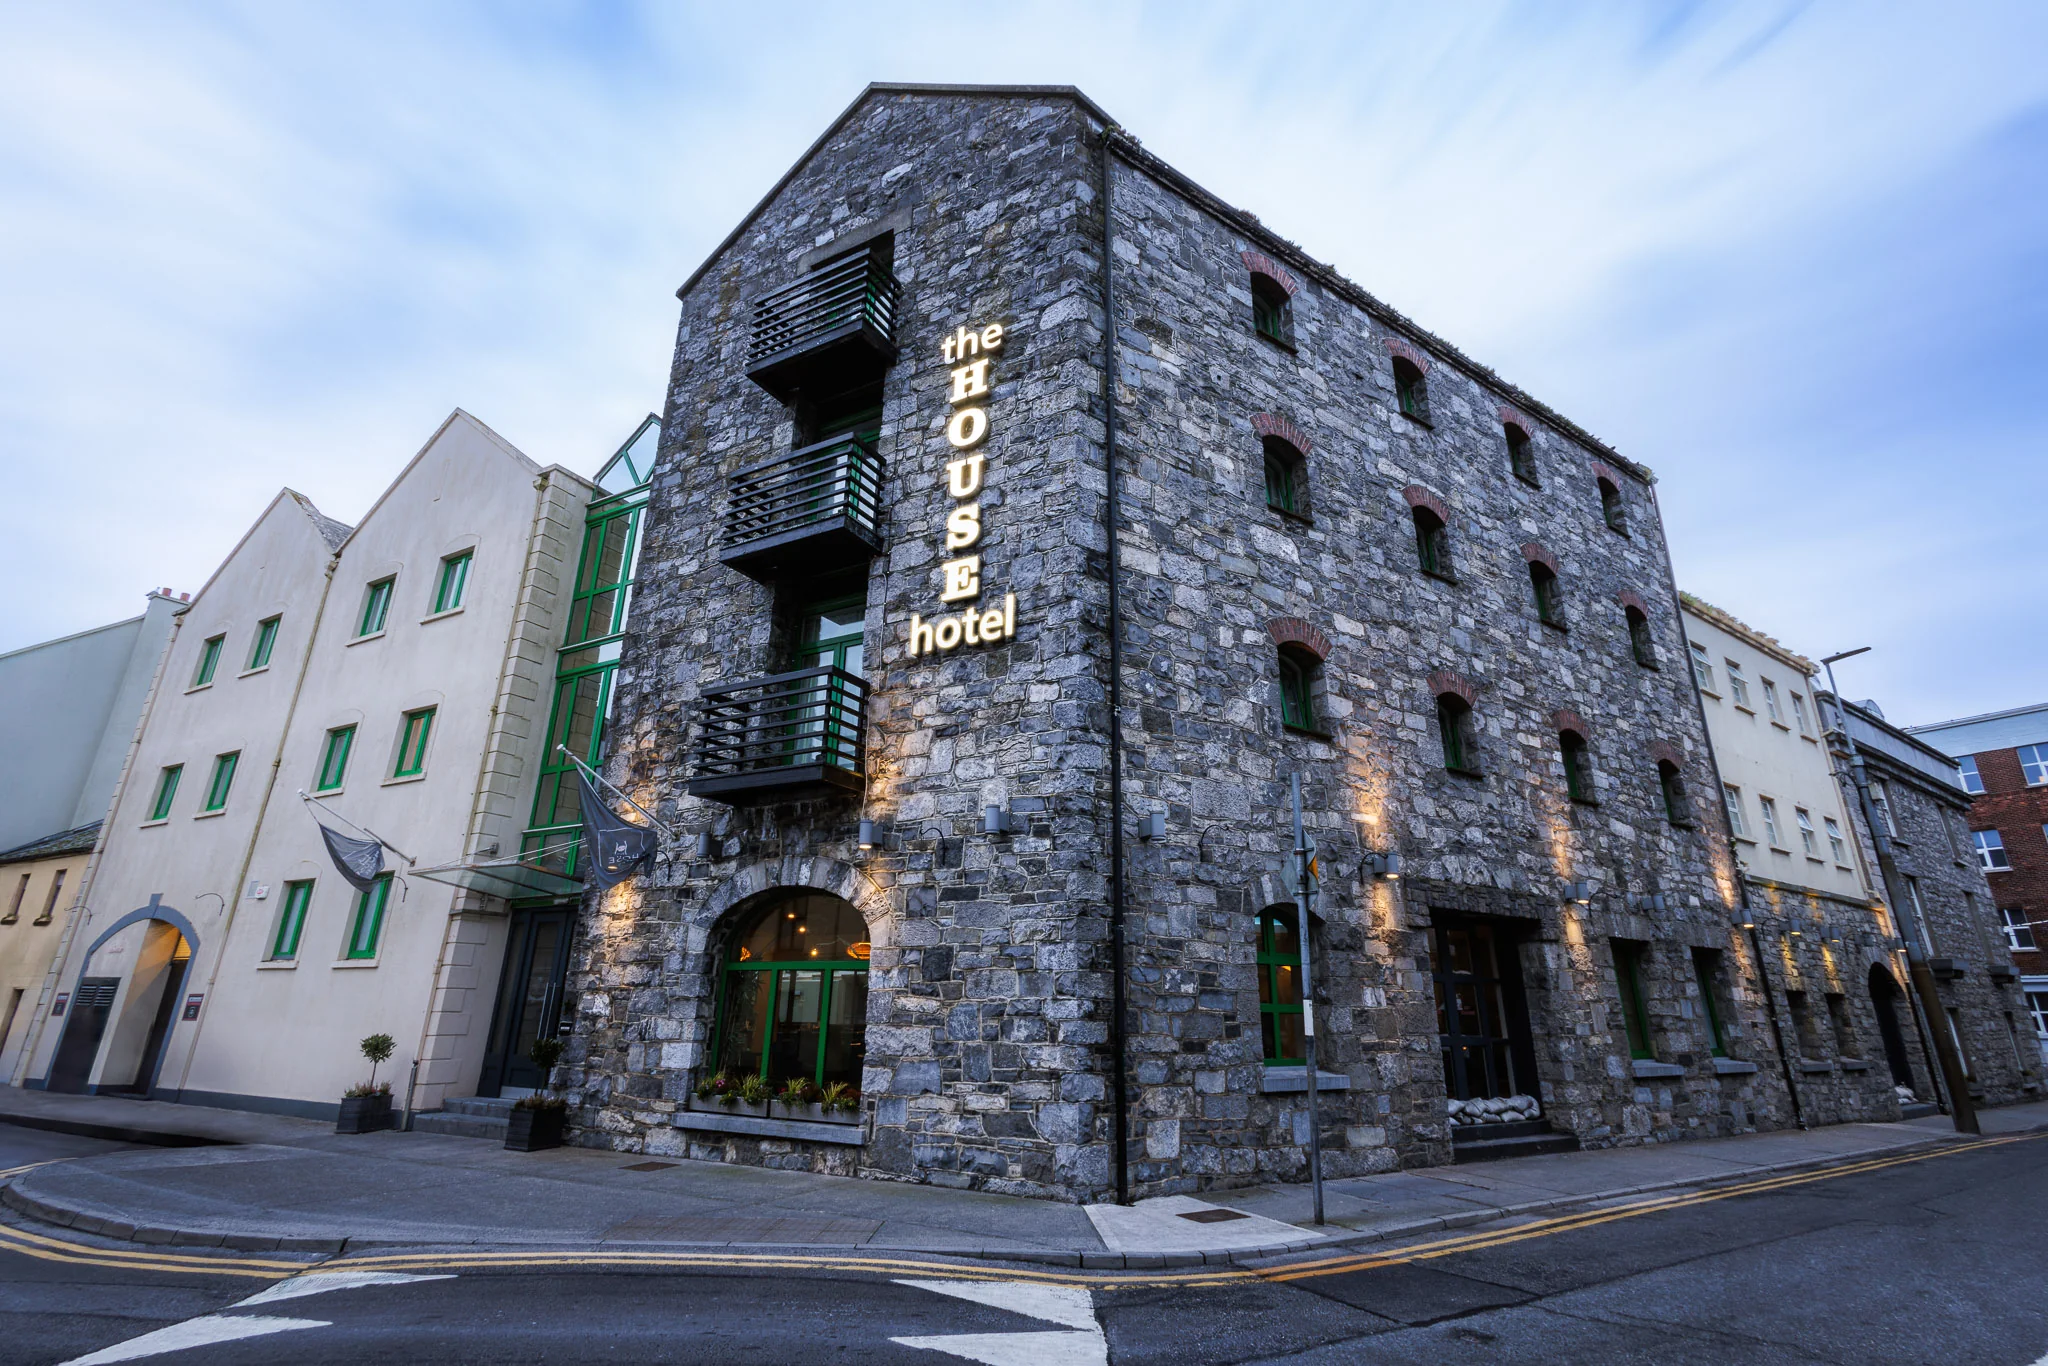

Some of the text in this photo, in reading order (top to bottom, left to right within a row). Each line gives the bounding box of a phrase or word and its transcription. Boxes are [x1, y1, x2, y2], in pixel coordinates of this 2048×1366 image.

[941, 324, 1003, 364] the
[940, 357, 989, 601] HOUSE
[910, 593, 1015, 655] hotel
